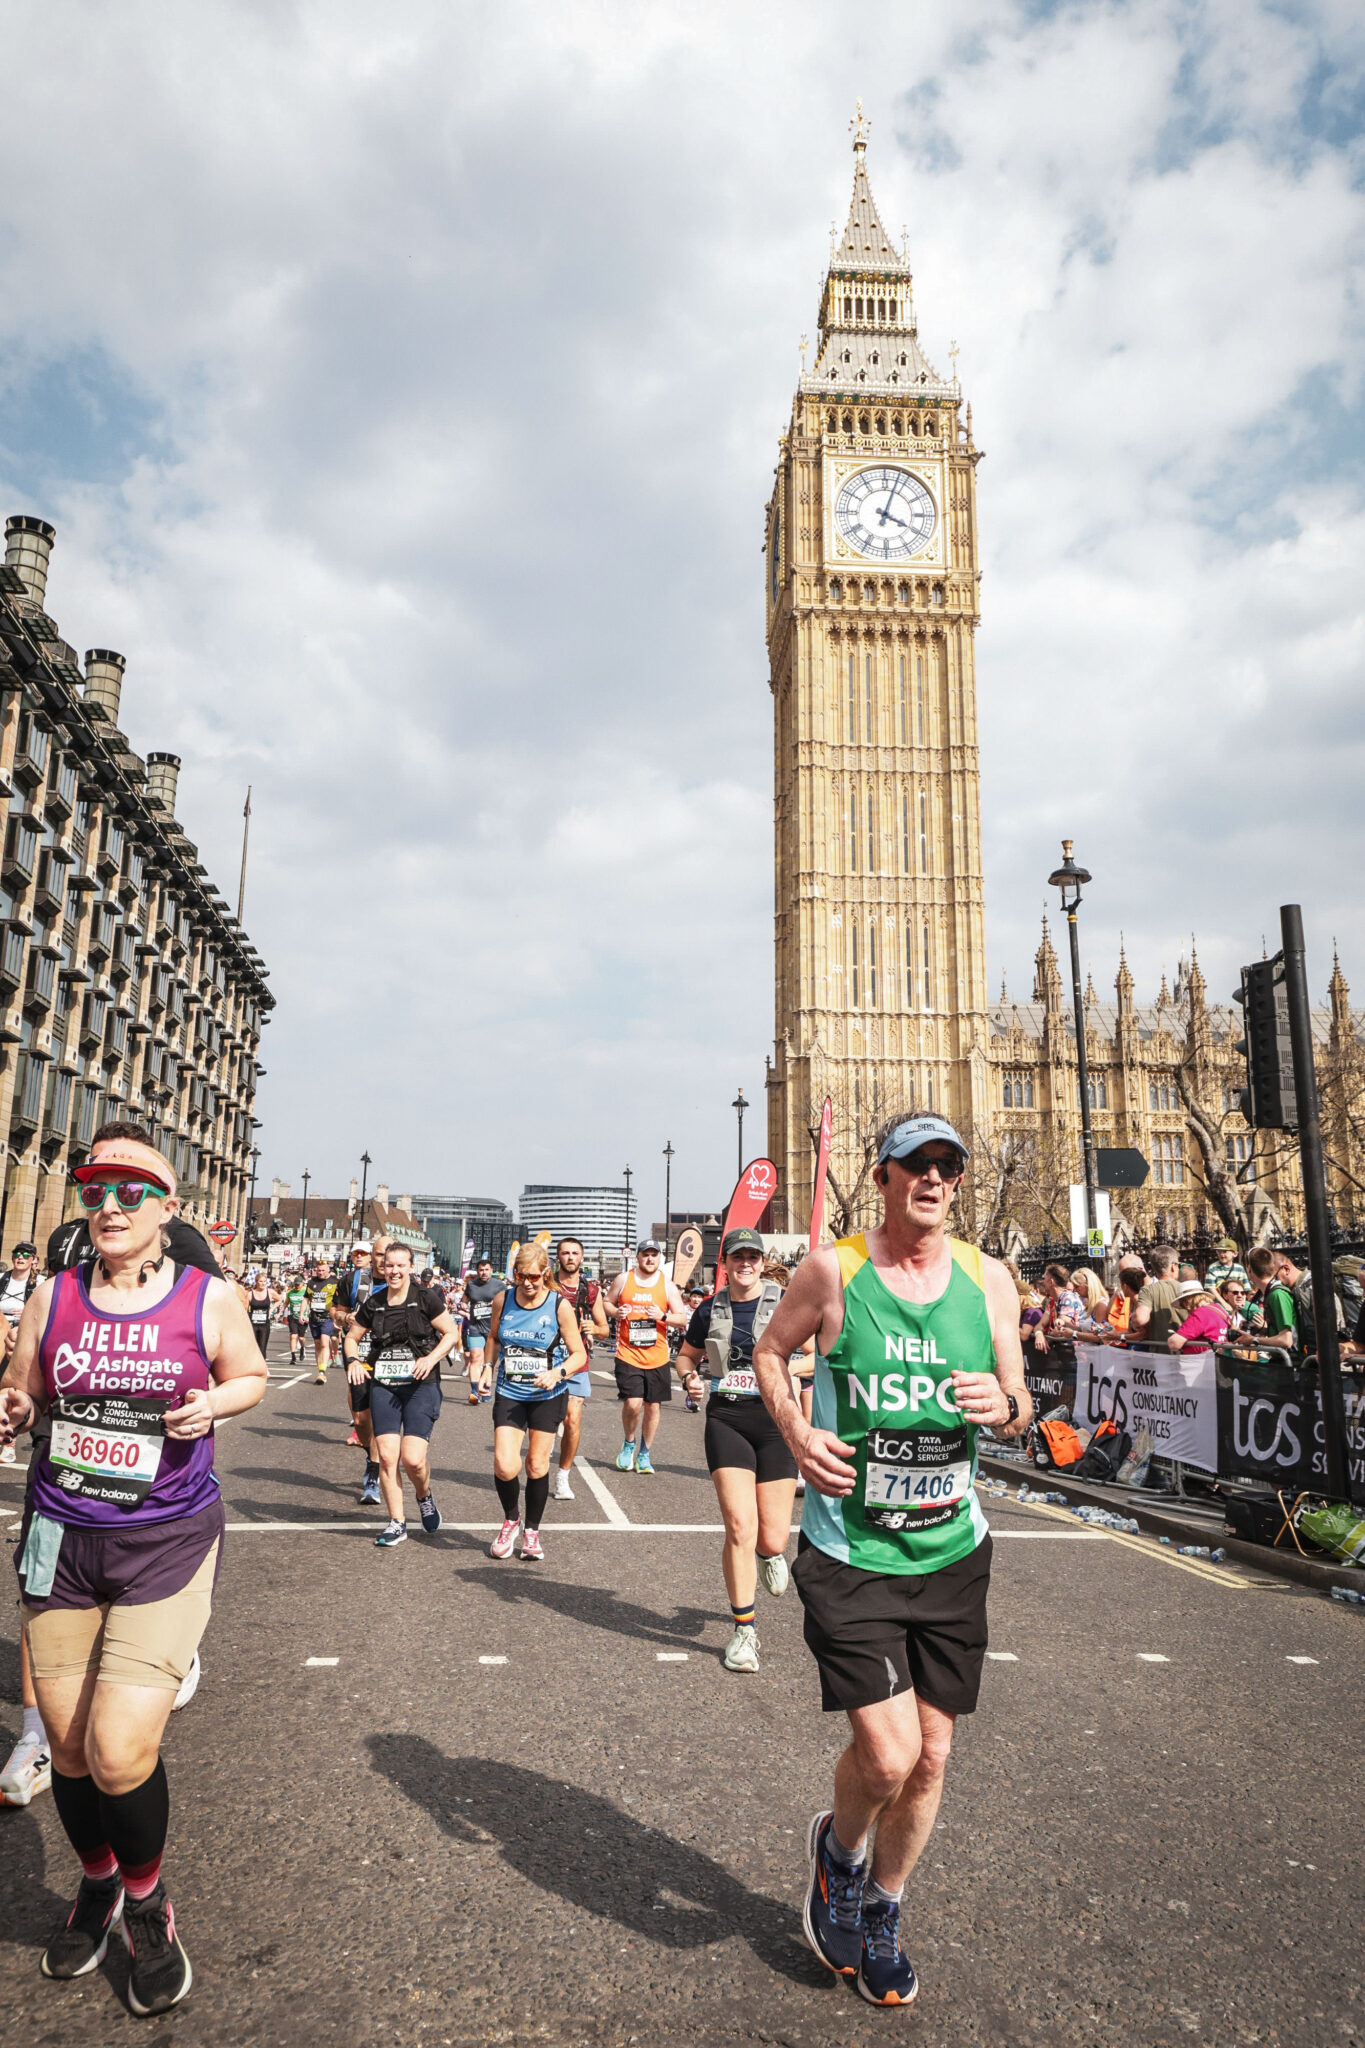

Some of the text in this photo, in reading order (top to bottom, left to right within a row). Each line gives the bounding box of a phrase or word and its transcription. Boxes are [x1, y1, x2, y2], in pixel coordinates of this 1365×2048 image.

[79, 1321, 159, 1353] HELEN
[885, 1335, 947, 1365] NEIL
[94, 1356, 183, 1376] Ashgate
[381, 1363, 409, 1375] 75374
[89, 1373, 176, 1393] Hospice
[847, 1372, 966, 1414] NSPC
[1024, 1375, 1064, 1396] ULTANCY
[104, 1400, 130, 1410] TATA
[1087, 1362, 1127, 1431] tcs
[1132, 1391, 1198, 1419] CONSULTANCY
[60, 1398, 101, 1422] tcs
[103, 1408, 162, 1422] CONSULTANCY
[101, 1415, 139, 1428] SERVICES
[1132, 1415, 1171, 1440] SEVICES
[1232, 1378, 1302, 1467] tcs
[68, 1432, 140, 1468] 36960
[874, 1431, 914, 1460] tcs
[917, 1440, 962, 1453] CONSULTANCY
[918, 1436, 942, 1444] TATA
[917, 1452, 950, 1462] SERVICES
[81, 1485, 138, 1501] new balance
[884, 1473, 956, 1500] 71406
[906, 1519, 924, 1529] new
